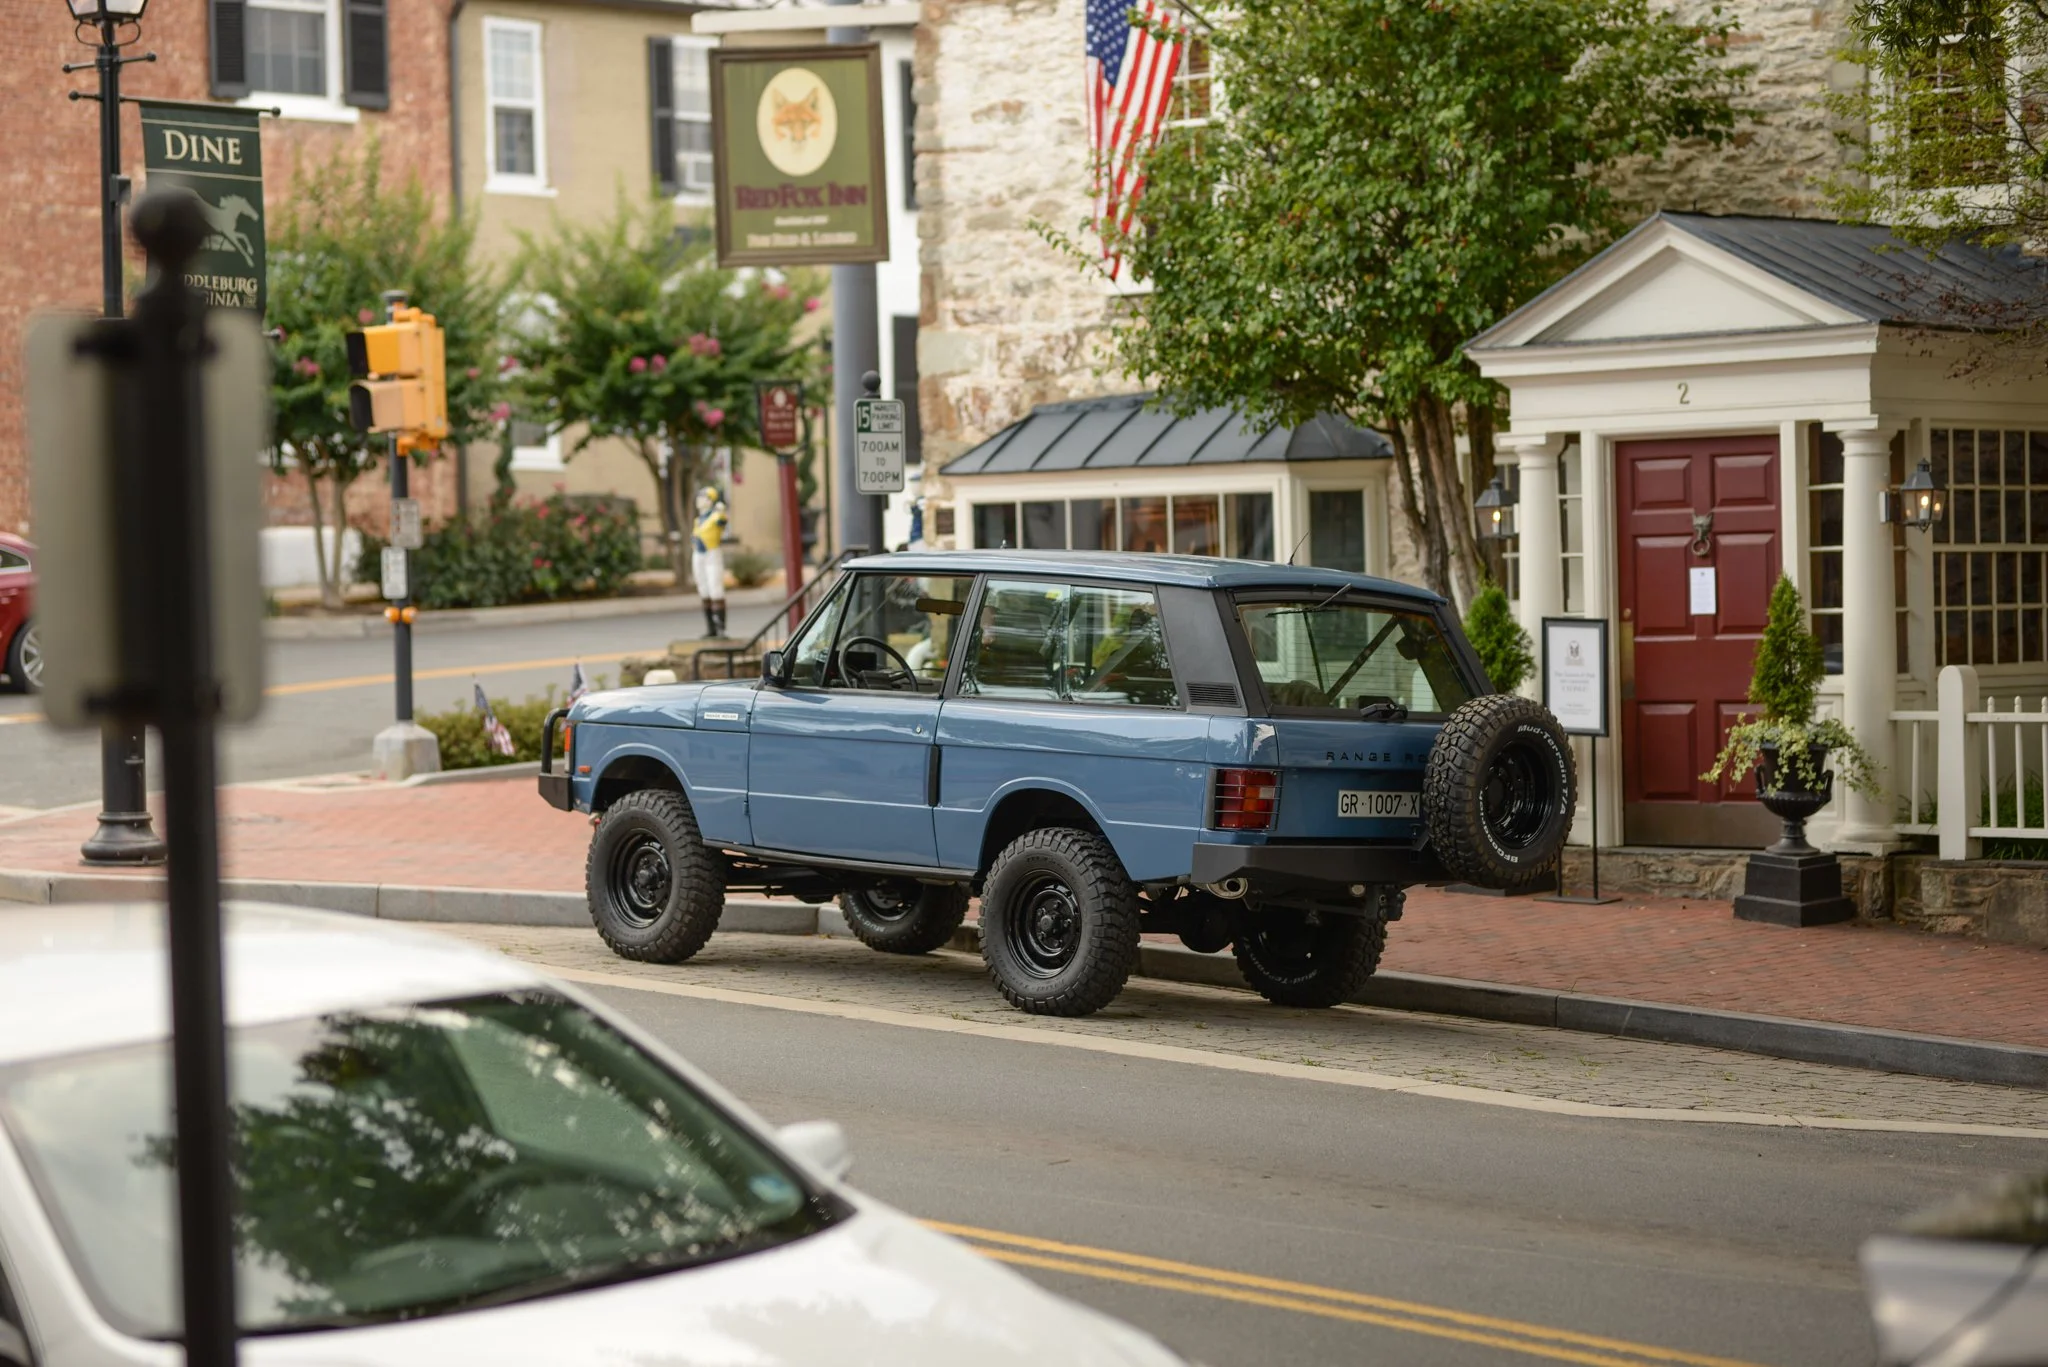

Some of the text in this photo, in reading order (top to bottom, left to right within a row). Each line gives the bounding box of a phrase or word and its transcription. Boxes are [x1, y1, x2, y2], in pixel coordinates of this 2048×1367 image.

[162, 129, 243, 165] DINE
[184, 274, 257, 295] DDLEBURG
[1677, 382, 1690, 404] 2
[857, 405, 870, 429] 15
[872, 413, 900, 421] PARKING
[878, 422, 894, 430] LIMIT
[875, 457, 886, 466] TO
[1326, 752, 1391, 762] RANGE
